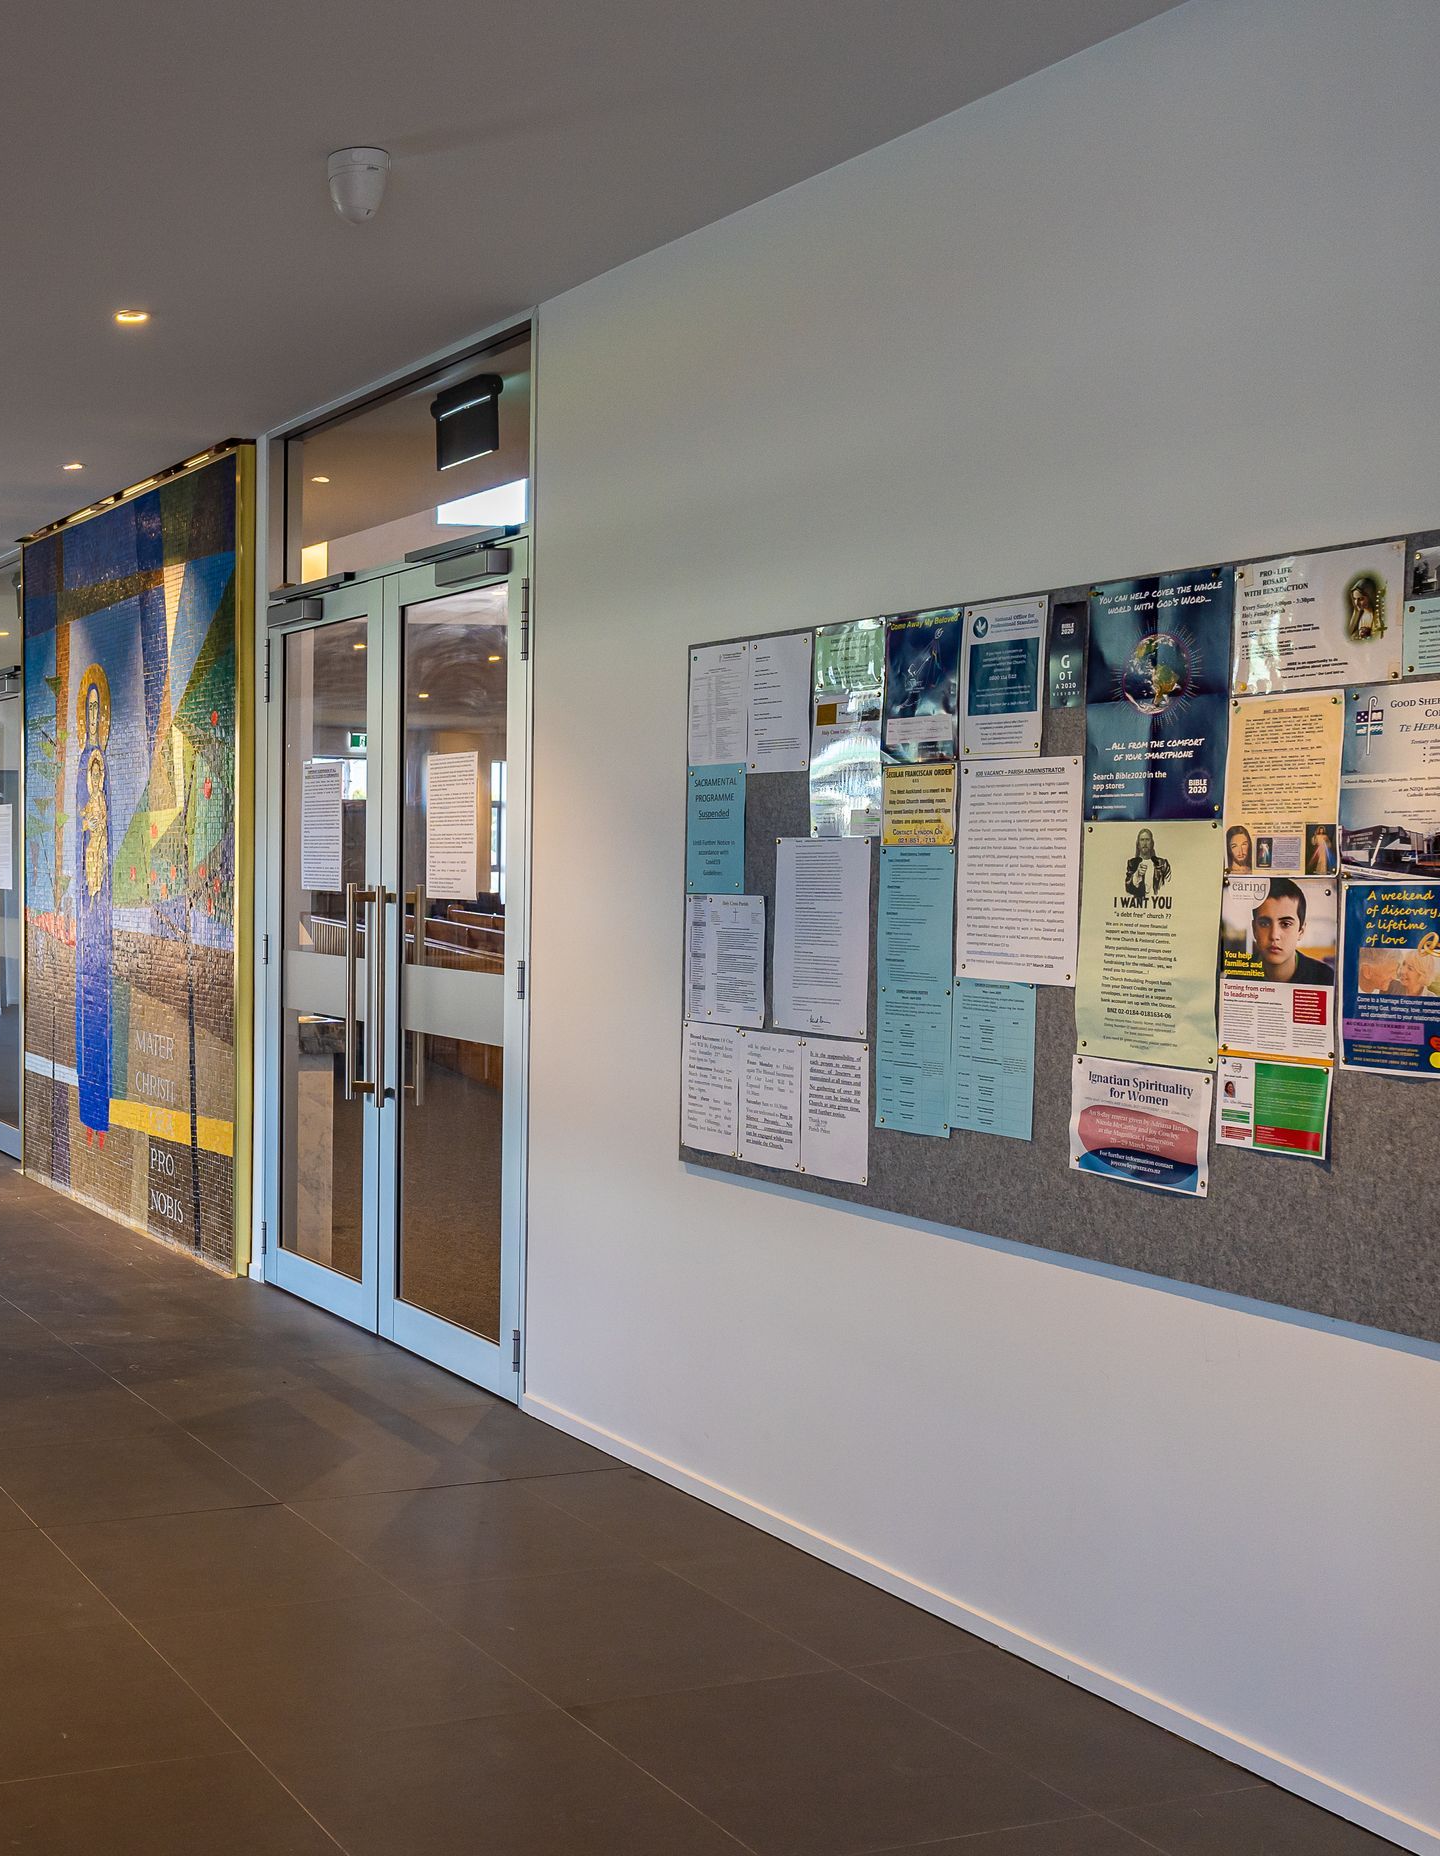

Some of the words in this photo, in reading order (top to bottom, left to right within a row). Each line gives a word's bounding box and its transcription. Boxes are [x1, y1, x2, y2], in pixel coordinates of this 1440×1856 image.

[1263, 577, 1288, 586] ROSARY
[1099, 596, 1113, 605] YOU
[1115, 594, 1128, 603] CAN
[1130, 591, 1149, 601] HELP
[1151, 588, 1174, 598] COVER
[1177, 585, 1192, 594] THE
[1194, 581, 1223, 591] WHOLE
[1108, 605, 1131, 615] WORLD
[1134, 602, 1155, 611] WITH
[1157, 597, 1179, 609] GOD'S
[891, 622, 905, 631] Come
[907, 620, 922, 629] Away
[924, 618, 934, 626] My
[935, 615, 958, 624] Beloved
[1061, 655, 1070, 668] G
[1390, 700, 1416, 708] GOOD
[1400, 724, 1411, 732] TE
[1413, 723, 1440, 731] HEPA
[1167, 738, 1205, 747] COMFORT
[1144, 751, 1194, 759] SMARTPHONE
[886, 770, 904, 778] SECULAR
[905, 769, 933, 777] FRANCISCAN
[1093, 773, 1114, 781] Search
[1115, 771, 1146, 779] Bible2020
[695, 778, 737, 787] SACRAMENTAL
[1188, 786, 1207, 794] 2020
[695, 793, 734, 803] PROGRAMME
[699, 809, 729, 818] Suspended
[1232, 882, 1266, 900] caring
[1367, 891, 1376, 900] A
[1381, 890, 1435, 900] weekend
[1114, 897, 1117, 908] I
[1120, 897, 1149, 908] WANT
[1151, 896, 1172, 909] YOU
[1366, 905, 1379, 917] of
[1378, 920, 1427, 932] lifetime
[1366, 934, 1378, 946] of
[1381, 934, 1407, 944] love
[1238, 951, 1252, 960] help
[1224, 969, 1264, 977] communities
[1230, 991, 1258, 999] leadership
[136, 1030, 174, 1061] MATER
[135, 1071, 175, 1103] CHRISTI
[1089, 1071, 1130, 1086] Ignatian
[1133, 1078, 1193, 1099] Spirituality
[1110, 1088, 1125, 1098] for
[1128, 1090, 1169, 1106] Women
[1128, 1141, 1145, 1149] March
[150, 1149, 174, 1177] PRO
[1108, 1152, 1125, 1160] further
[1126, 1155, 1154, 1165] information
[1155, 1161, 1173, 1169] contact
[150, 1188, 184, 1224] NOBIS
